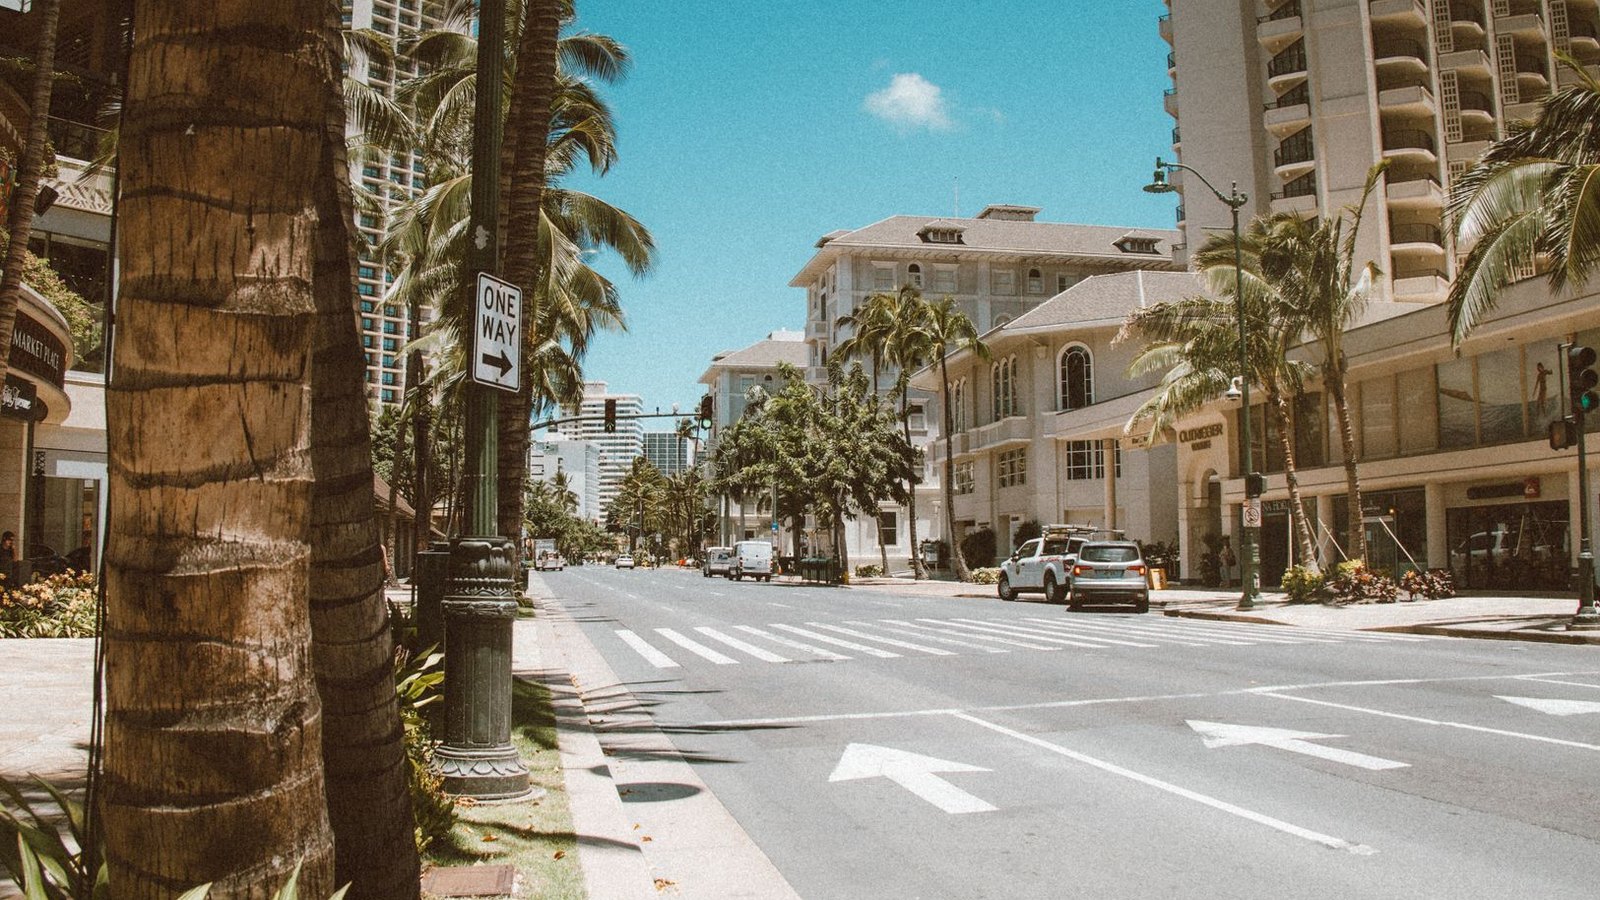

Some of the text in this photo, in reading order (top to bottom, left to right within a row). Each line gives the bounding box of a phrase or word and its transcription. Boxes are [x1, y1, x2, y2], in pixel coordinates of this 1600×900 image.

[484, 286, 515, 318] ONE
[483, 314, 516, 346] WAY
[12, 329, 59, 370] MARKET PLACE
